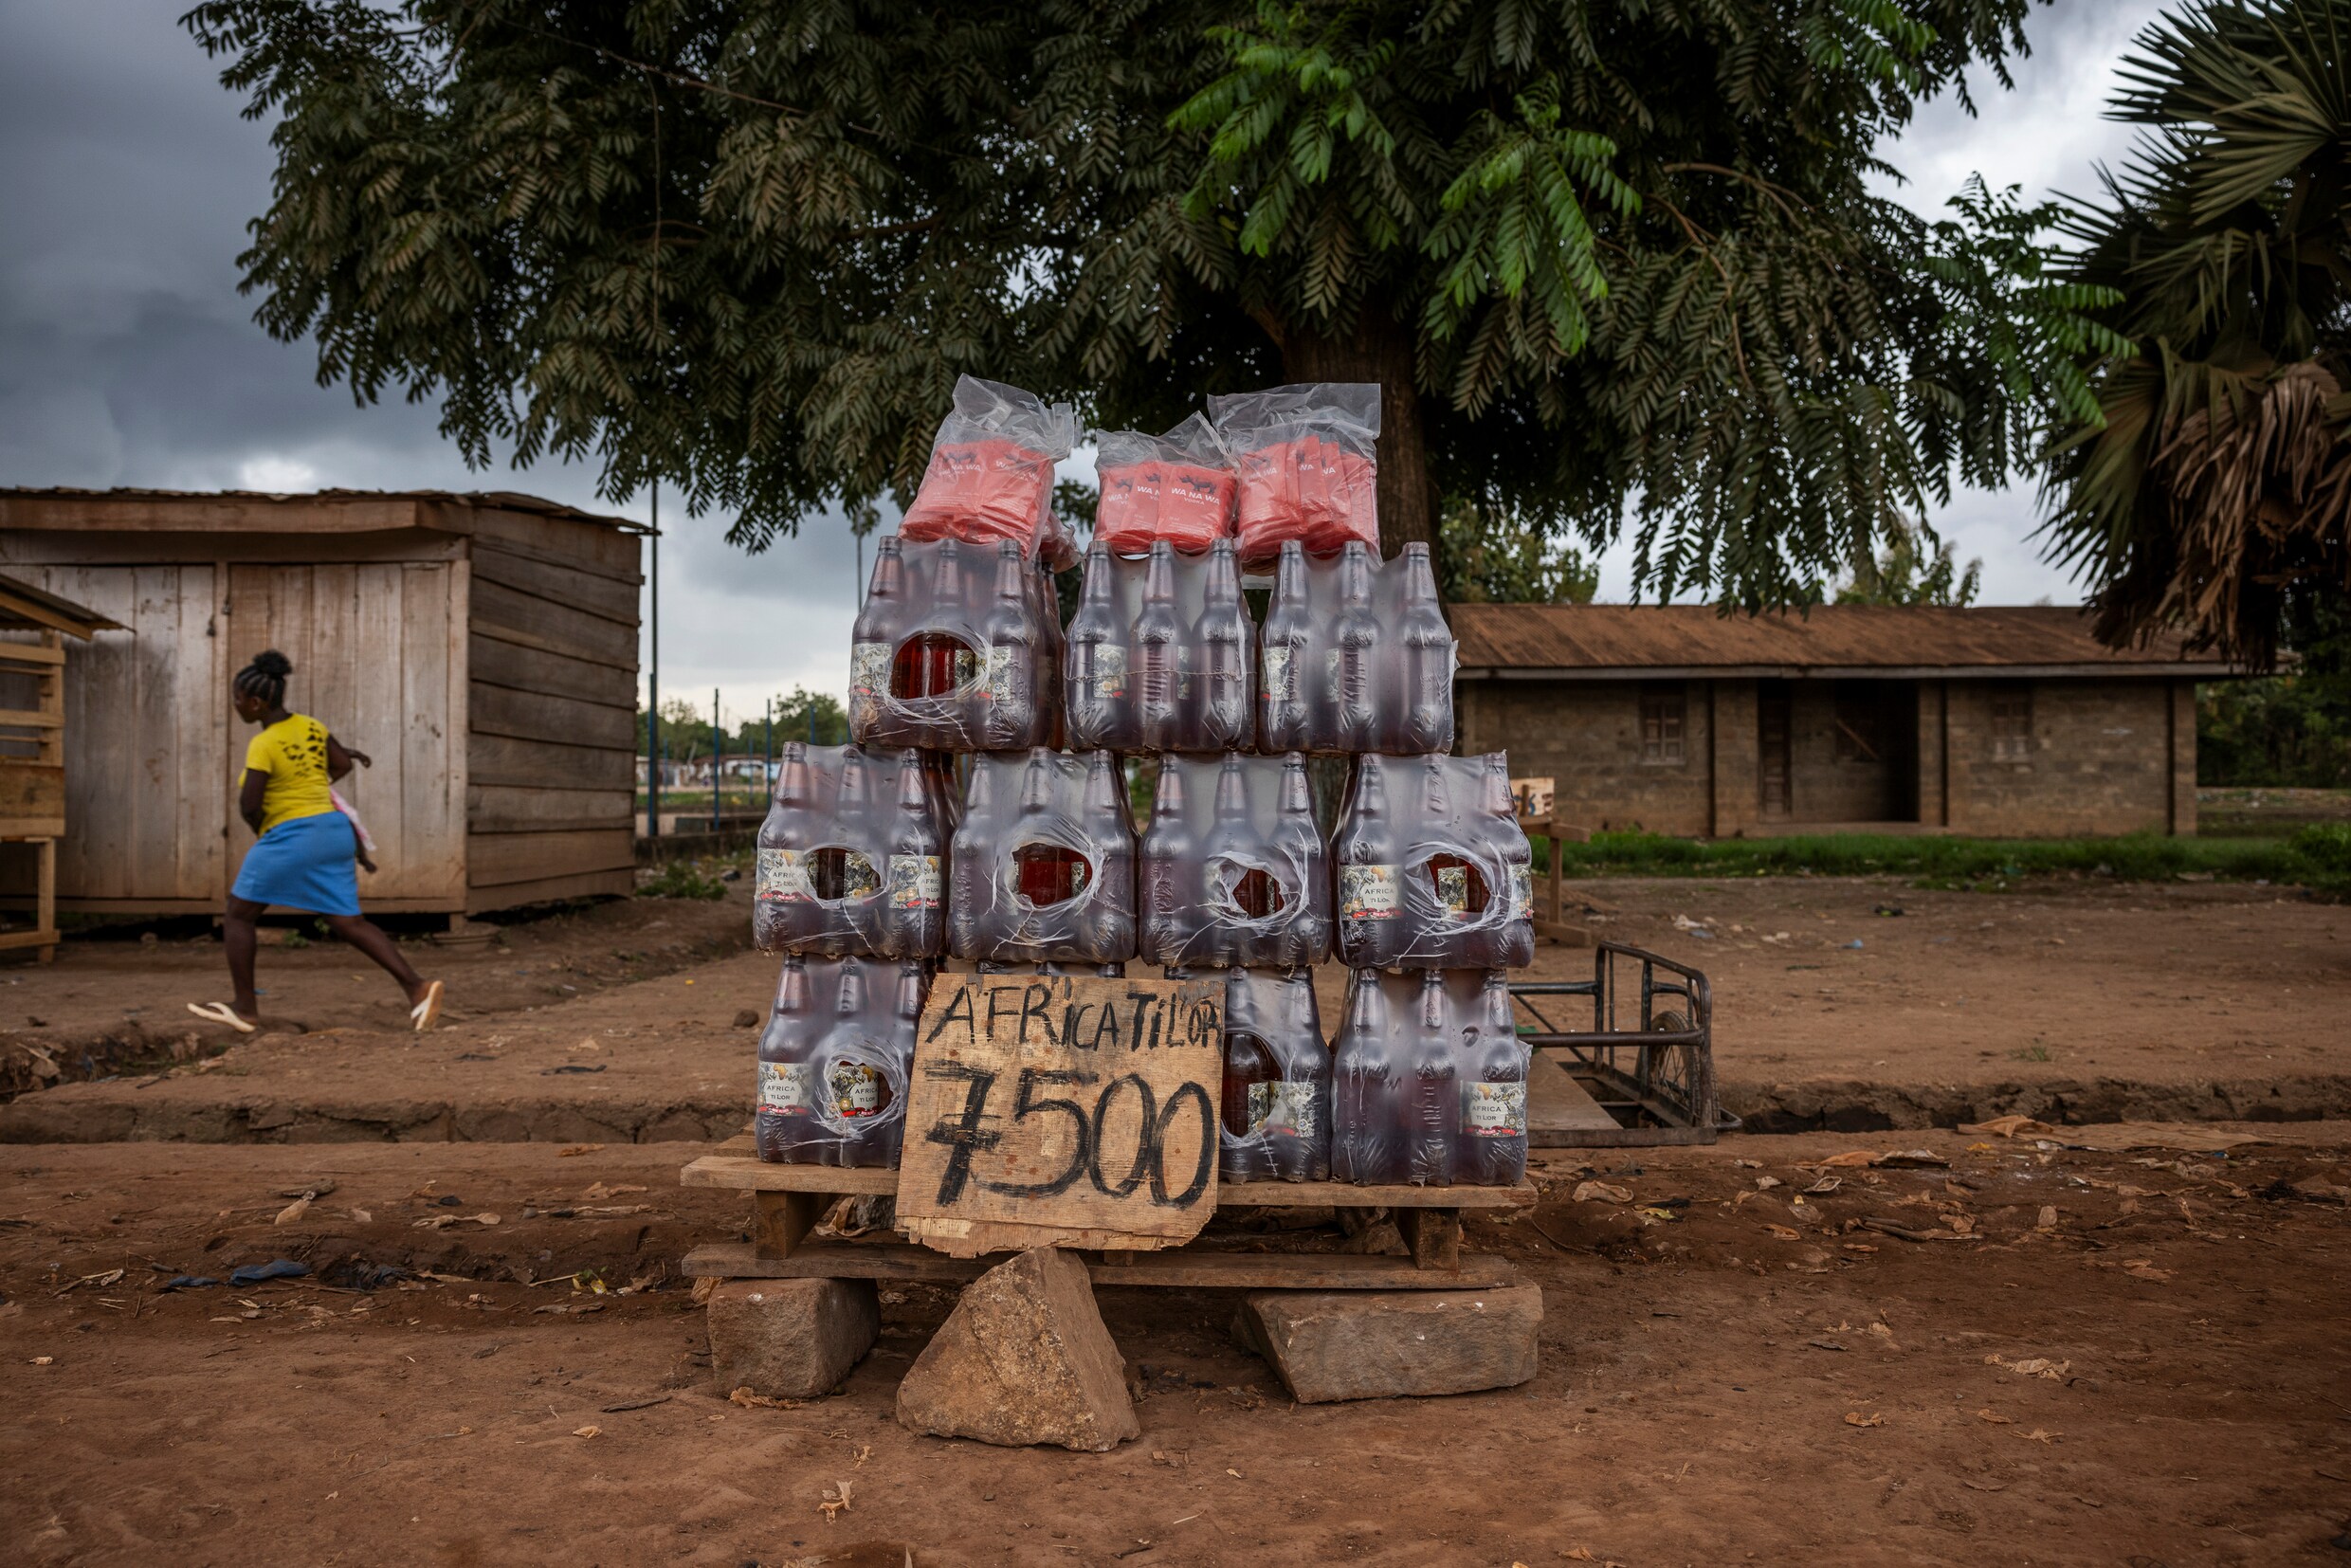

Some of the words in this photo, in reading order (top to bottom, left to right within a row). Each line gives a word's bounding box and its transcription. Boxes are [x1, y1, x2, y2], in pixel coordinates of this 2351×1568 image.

[1137, 485, 1154, 496] WA
[1171, 487, 1187, 497] WA
[1188, 491, 1203, 501] NA
[1204, 494, 1220, 505] WA
[1183, 497, 1205, 505] VODKA
[923, 1060, 1217, 1210] 7500
